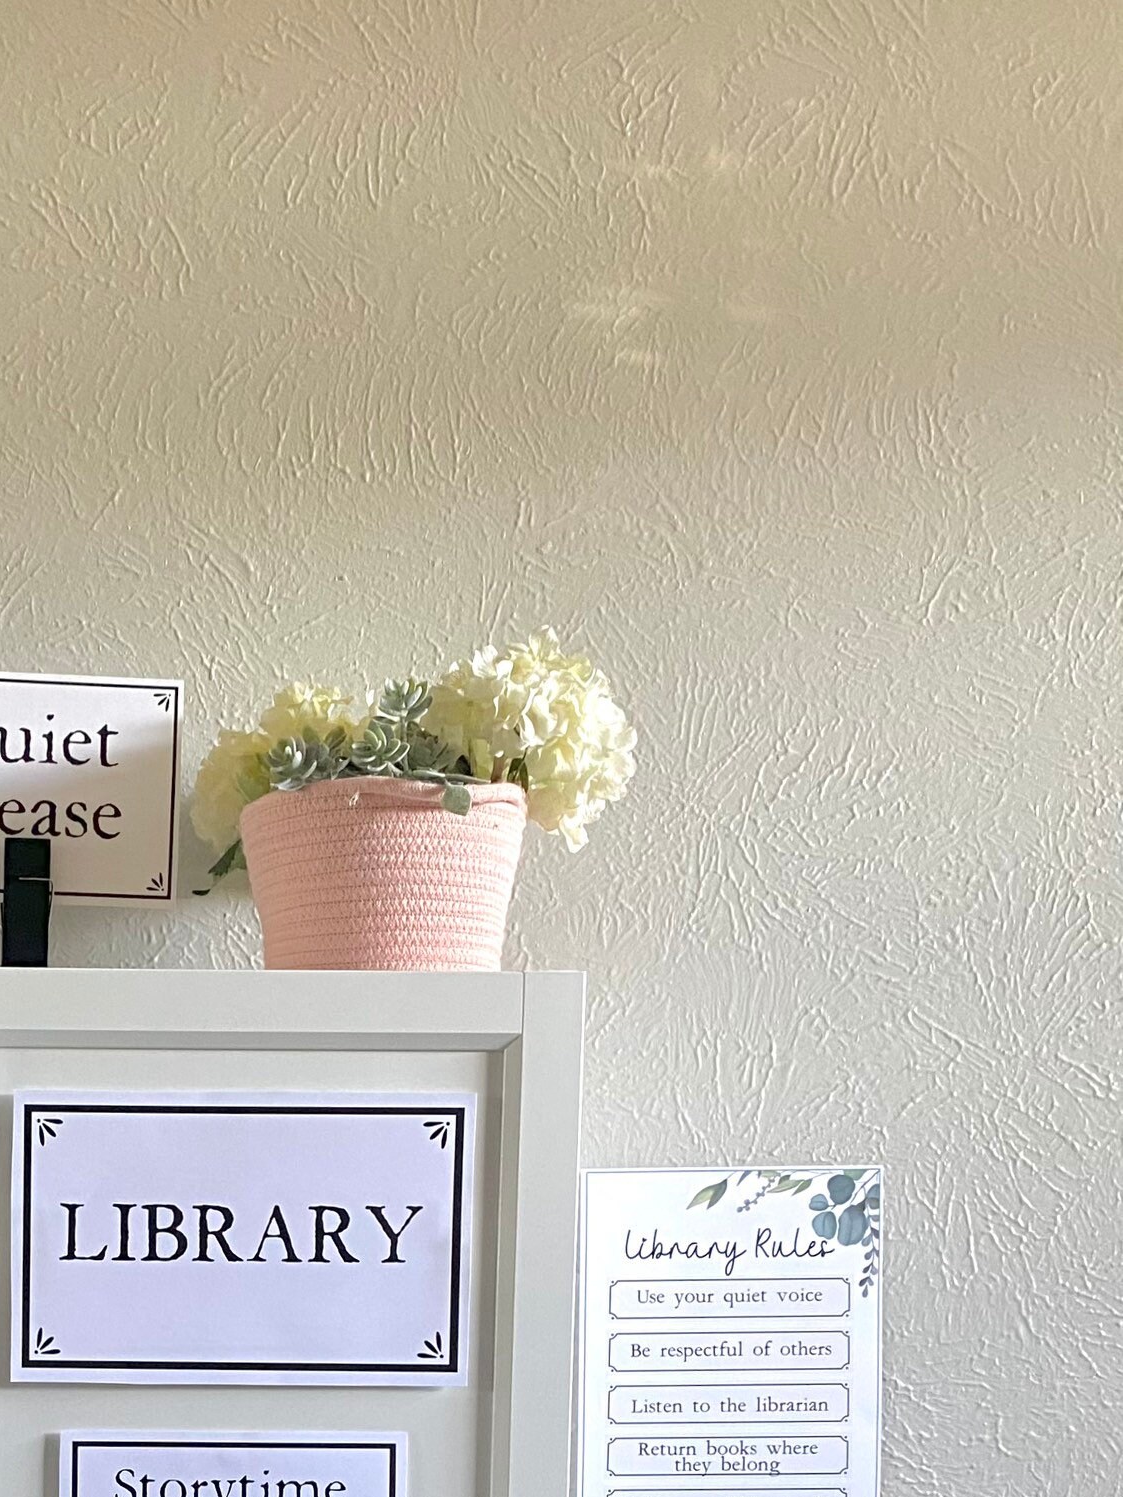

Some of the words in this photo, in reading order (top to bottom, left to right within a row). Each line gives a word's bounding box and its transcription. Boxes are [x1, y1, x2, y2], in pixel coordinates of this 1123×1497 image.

[59, 1203, 423, 1263] LIBRARY
[756, 1227, 836, 1257] Rules
[638, 1290, 664, 1303] Use
[675, 1293, 714, 1308] your
[724, 1289, 766, 1308] quiet
[777, 1289, 822, 1301] voice
[632, 1344, 650, 1357] Be
[661, 1342, 742, 1362] respectful
[753, 1341, 772, 1355] of
[780, 1341, 831, 1355] others
[632, 1400, 682, 1413] Listen
[693, 1402, 710, 1412] to
[721, 1398, 746, 1412] the
[757, 1396, 828, 1412] librarian
[639, 1443, 696, 1455] Return
[707, 1441, 757, 1455] books
[767, 1441, 818, 1454] where
[674, 1457, 713, 1476] they
[720, 1456, 781, 1476] belong
